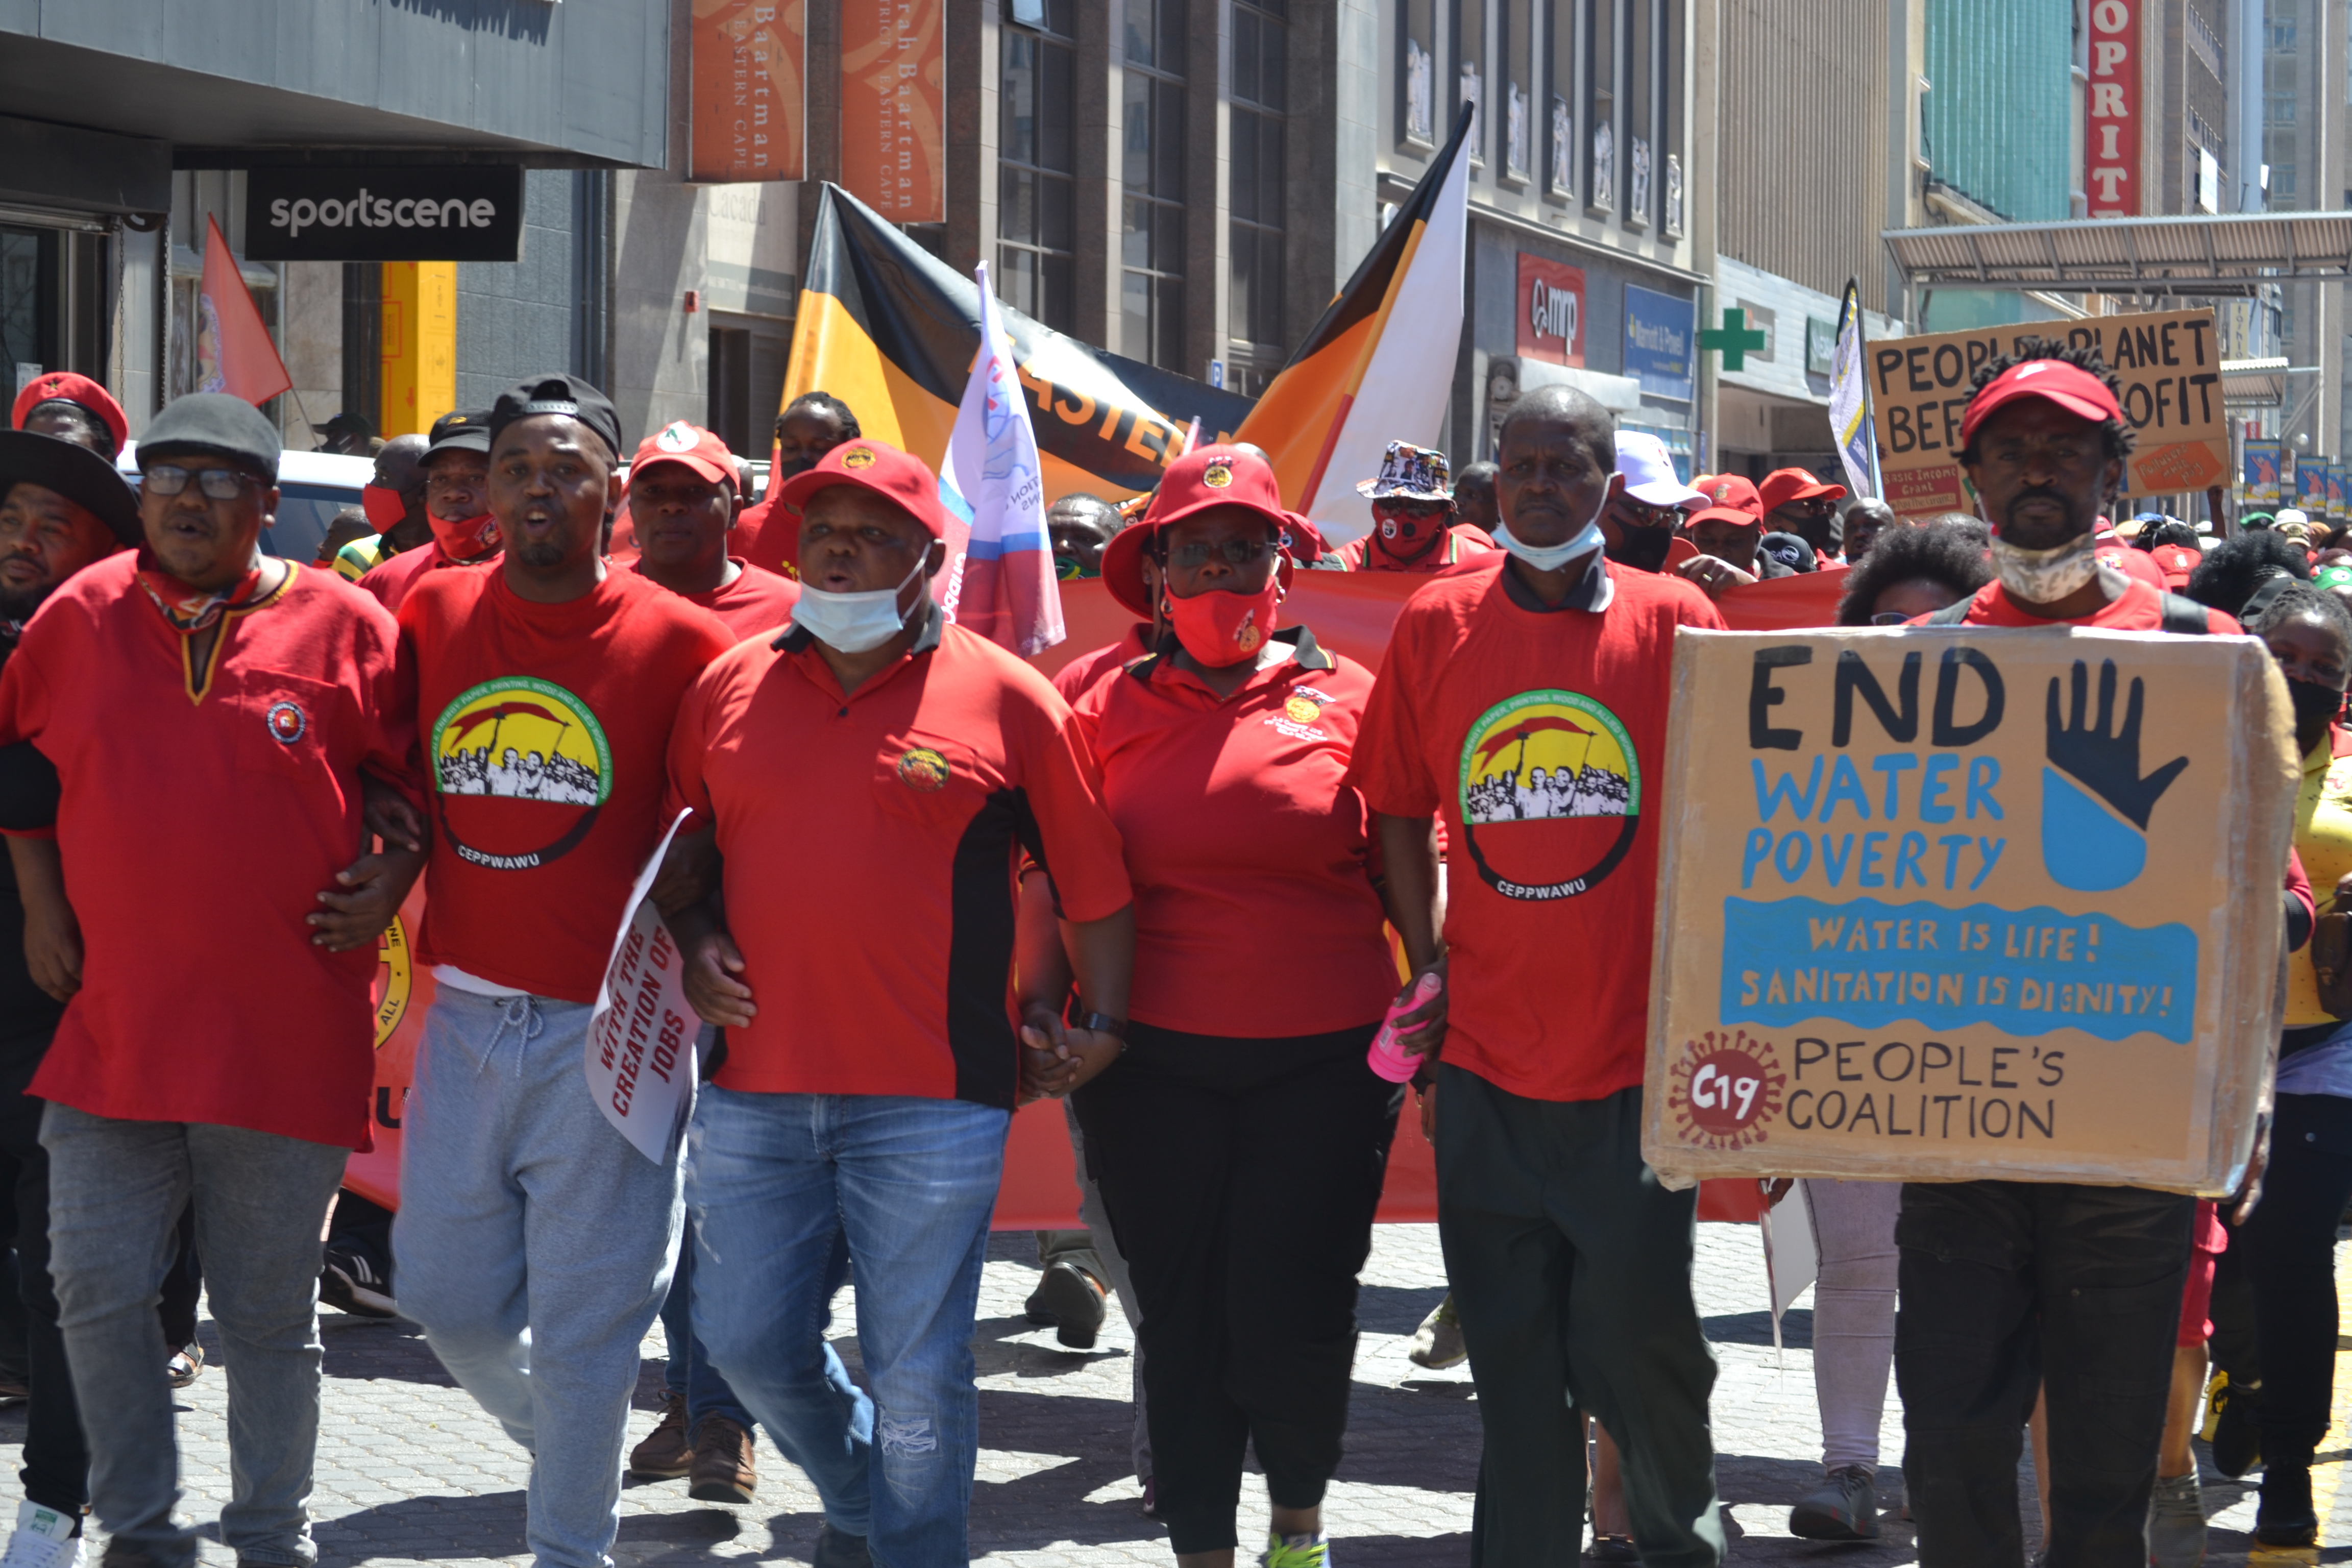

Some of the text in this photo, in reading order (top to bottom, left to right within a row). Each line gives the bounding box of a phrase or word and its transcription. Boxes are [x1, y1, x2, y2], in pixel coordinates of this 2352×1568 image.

[734, 20, 747, 169] EASTERN CAPE
[754, 6, 776, 167] Baartman
[880, 75, 892, 153] EASTERN
[2092, 0, 2128, 217] OPRIT
[899, 63, 918, 209] Baartman
[270, 188, 496, 237] sportscene
[880, 165, 893, 210] CAPE
[1548, 286, 1578, 356] mrp
[1212, 368, 1222, 387] P
[1883, 467, 1957, 485] Basic Income
[1901, 481, 1934, 496] Grant
[1748, 645, 2005, 750] END
[1552, 694, 1579, 705] WOOD
[1579, 700, 1597, 713] AND
[1596, 709, 1622, 734] ALLIED
[1619, 733, 1637, 776] WORKERS
[1630, 778, 1639, 807] UNION
[1751, 753, 2004, 824] WATER
[458, 845, 540, 869] CEPPWAWU
[1742, 828, 2006, 891] POVERTY
[1497, 878, 1586, 899] CEPPWAWU
[1808, 917, 1939, 953] WATER
[1959, 921, 1991, 951] IS
[380, 999, 400, 1026] ALL
[600, 987, 629, 1071] WITH
[620, 922, 645, 987] THE
[612, 925, 673, 1118] CREATION OF
[1740, 968, 2173, 1018] SANITATION IS DIGNITY!
[650, 1009, 686, 1084] JOBS
[1794, 1037, 2065, 1087] PEOPLE'S
[1691, 1063, 1759, 1120] C19
[1786, 1089, 2054, 1139] COALITION
